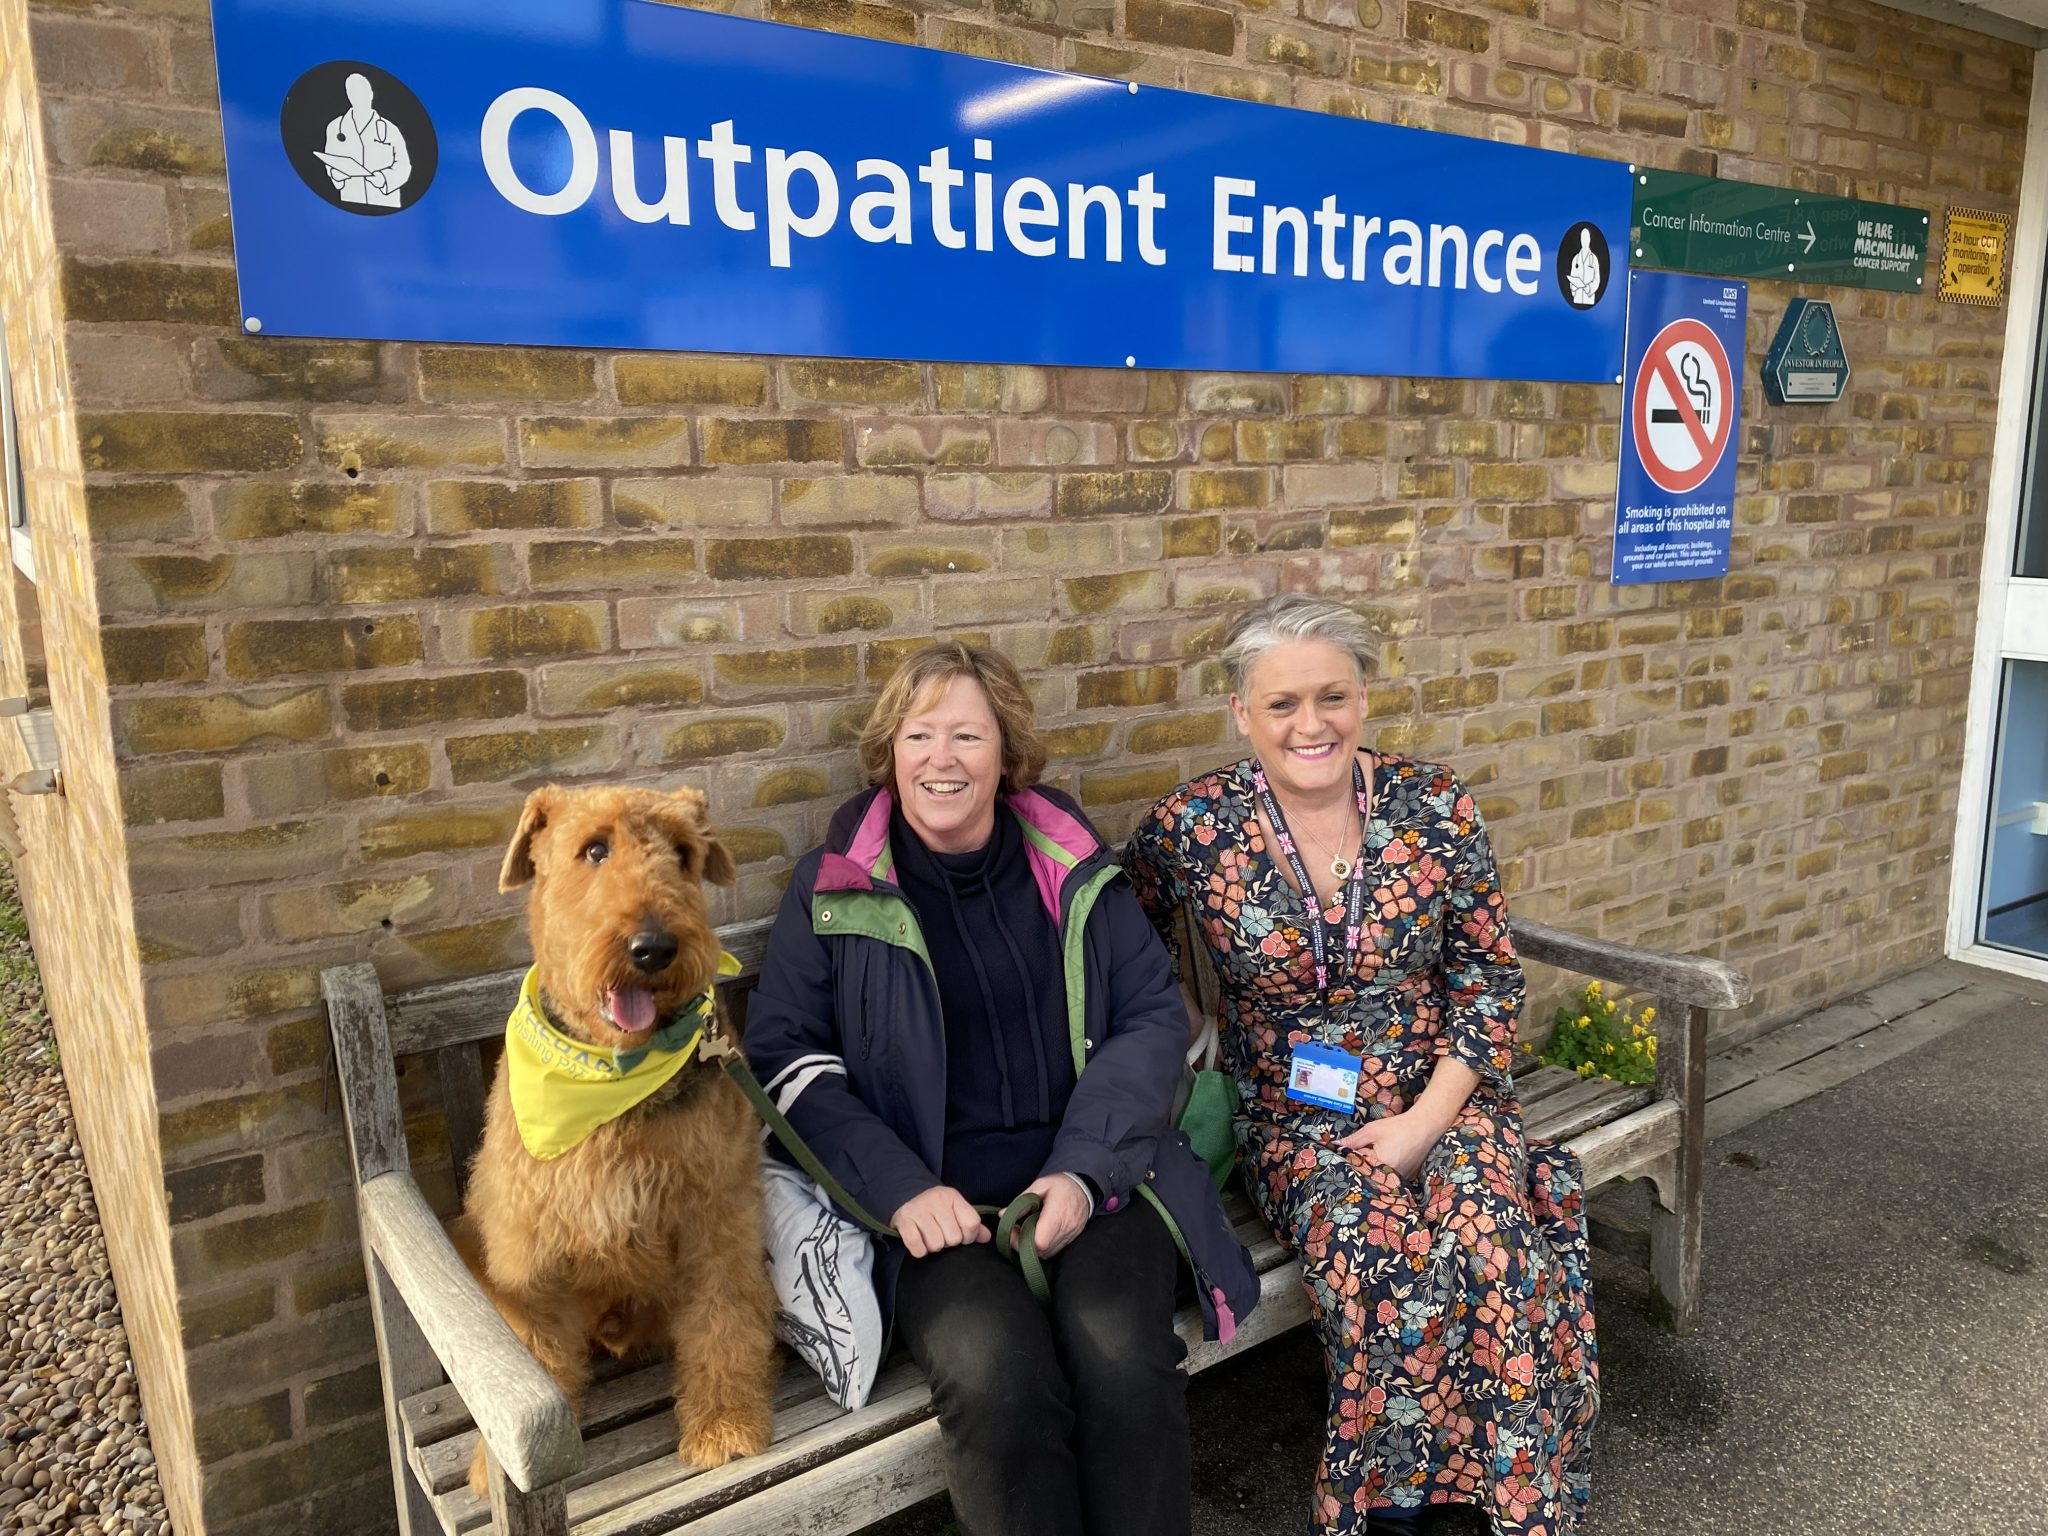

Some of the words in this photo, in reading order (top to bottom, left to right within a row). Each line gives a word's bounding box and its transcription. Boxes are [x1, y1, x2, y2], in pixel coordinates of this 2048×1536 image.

[480, 86, 1167, 268] Outpatient
[1212, 175, 1542, 296] Entrance
[1642, 207, 1686, 231] Cancer
[1689, 214, 1752, 238] Information
[1755, 221, 1791, 243] Centre
[1857, 220, 1873, 237] WE
[1874, 222, 1893, 240] ARE
[1953, 231, 1961, 243] 24
[1964, 233, 1979, 246] hour
[1981, 235, 2000, 248] CCTV
[1952, 248, 1989, 264] monitoring
[1990, 250, 1997, 262] in
[1853, 257, 1880, 269] CANCER
[1880, 259, 1911, 273] SUPPORT
[1958, 263, 1990, 276] operation
[1724, 288, 1736, 298] NHS
[1785, 359, 1814, 368] INVESTOR
[1815, 359, 1822, 368] IN
[1823, 360, 1844, 368] PEOPLE
[1625, 506, 1662, 521] Smoking
[1664, 506, 1671, 518] is
[1673, 504, 1714, 519] prohibited
[1715, 505, 1726, 516] on
[1618, 521, 1629, 534] all
[1631, 523, 1653, 533] areas
[1655, 521, 1666, 532] of
[1667, 520, 1682, 531] this
[1684, 518, 1715, 533] hospital
[1716, 518, 1730, 529] site
[1632, 563, 1643, 571] your
